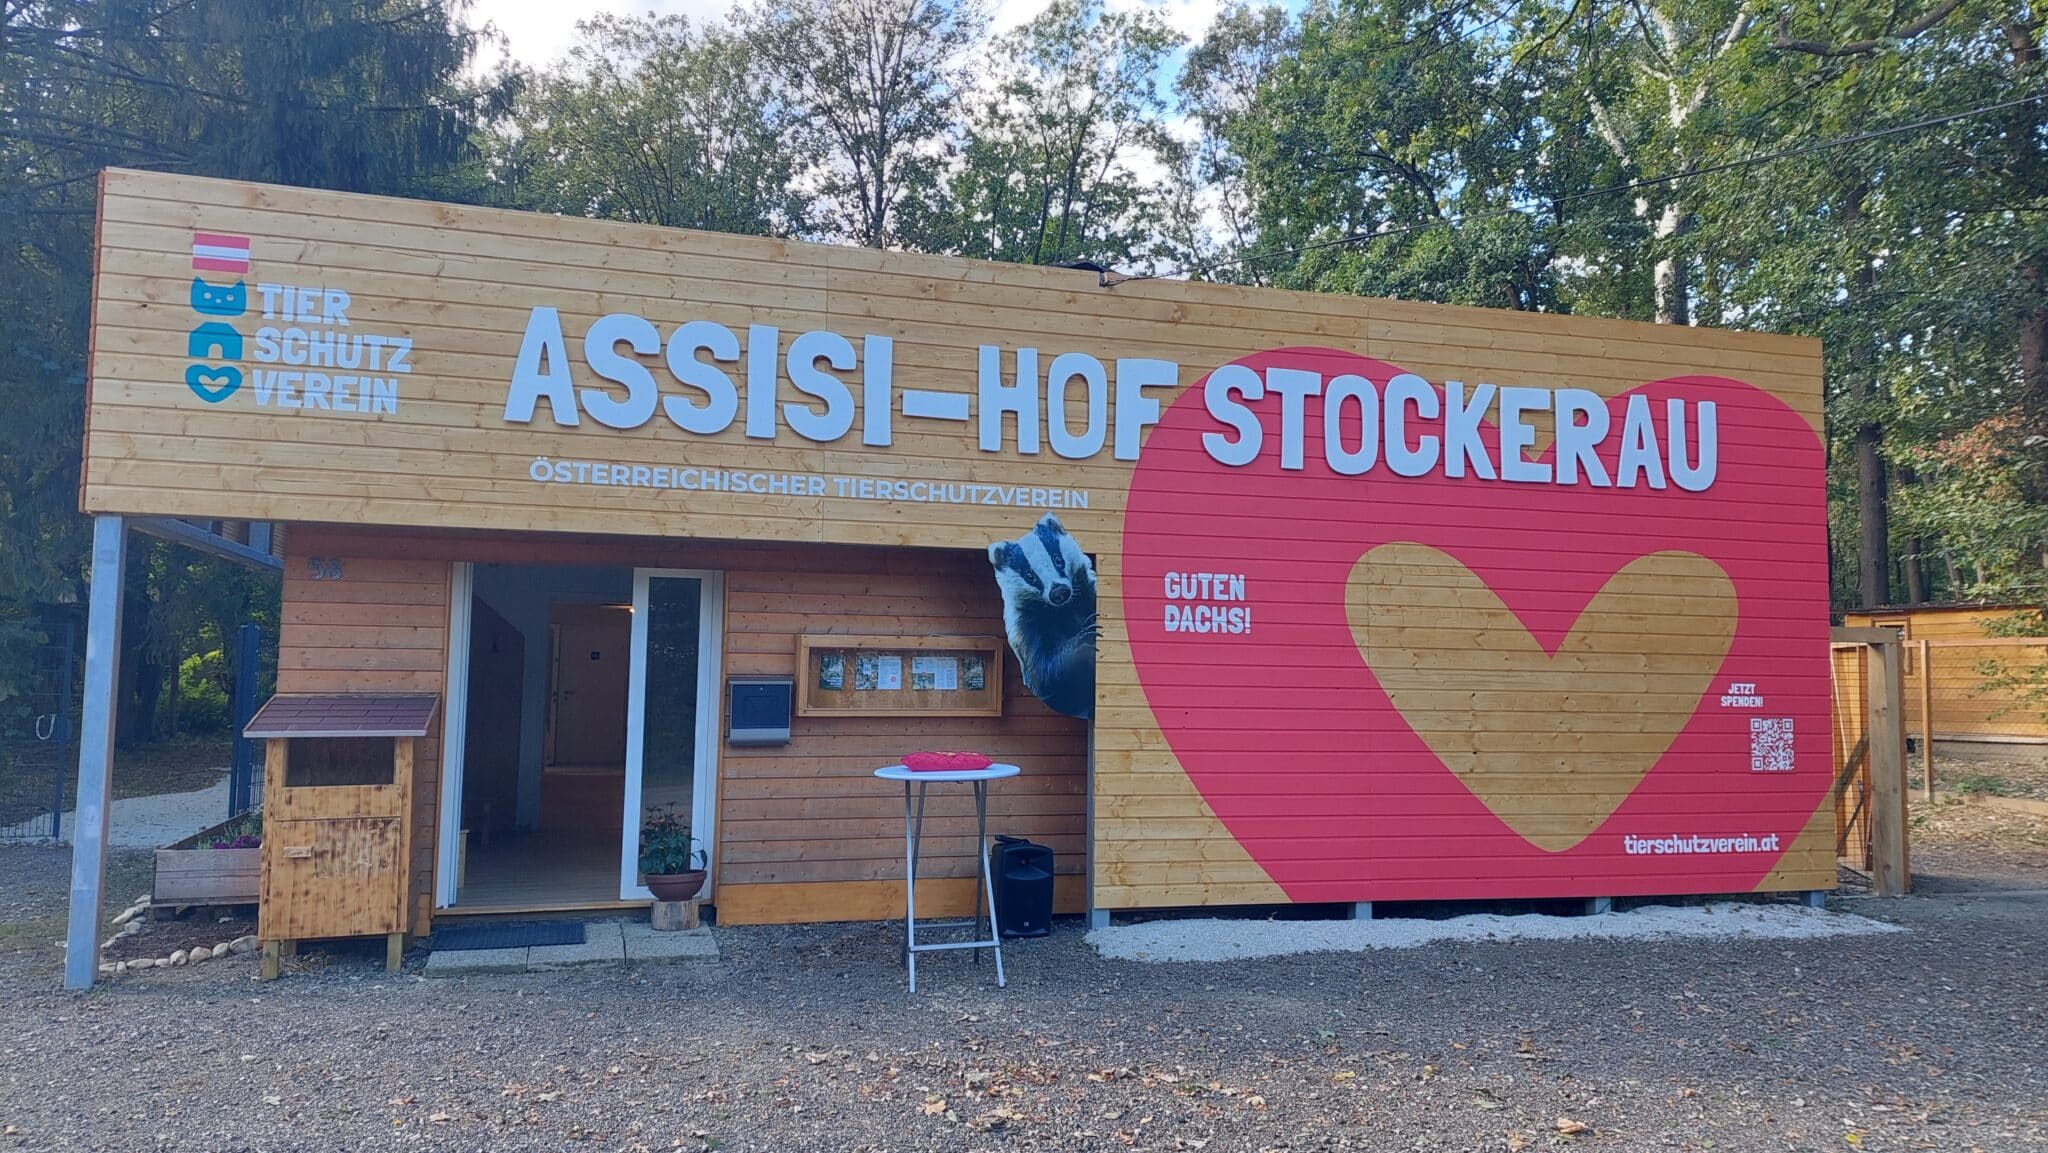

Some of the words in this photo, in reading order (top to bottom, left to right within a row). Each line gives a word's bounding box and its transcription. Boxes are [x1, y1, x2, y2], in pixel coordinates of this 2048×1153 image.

[256, 282, 352, 326] TIER
[253, 326, 413, 373] SCHUTZ
[252, 369, 398, 415] VEREIN
[1202, 363, 1719, 493] STOCKERAU
[529, 455, 826, 497] ÖSTERREICHISCHER
[832, 476, 1090, 510] TIERSCHUTZVEREIN
[1164, 571, 1246, 602] GUTEN
[1163, 604, 1252, 635] DACHS!
[1720, 695, 1763, 708] SPENDEN!
[1728, 683, 1756, 694] JETZT
[1624, 833, 1780, 855] tierschutzverein.at
